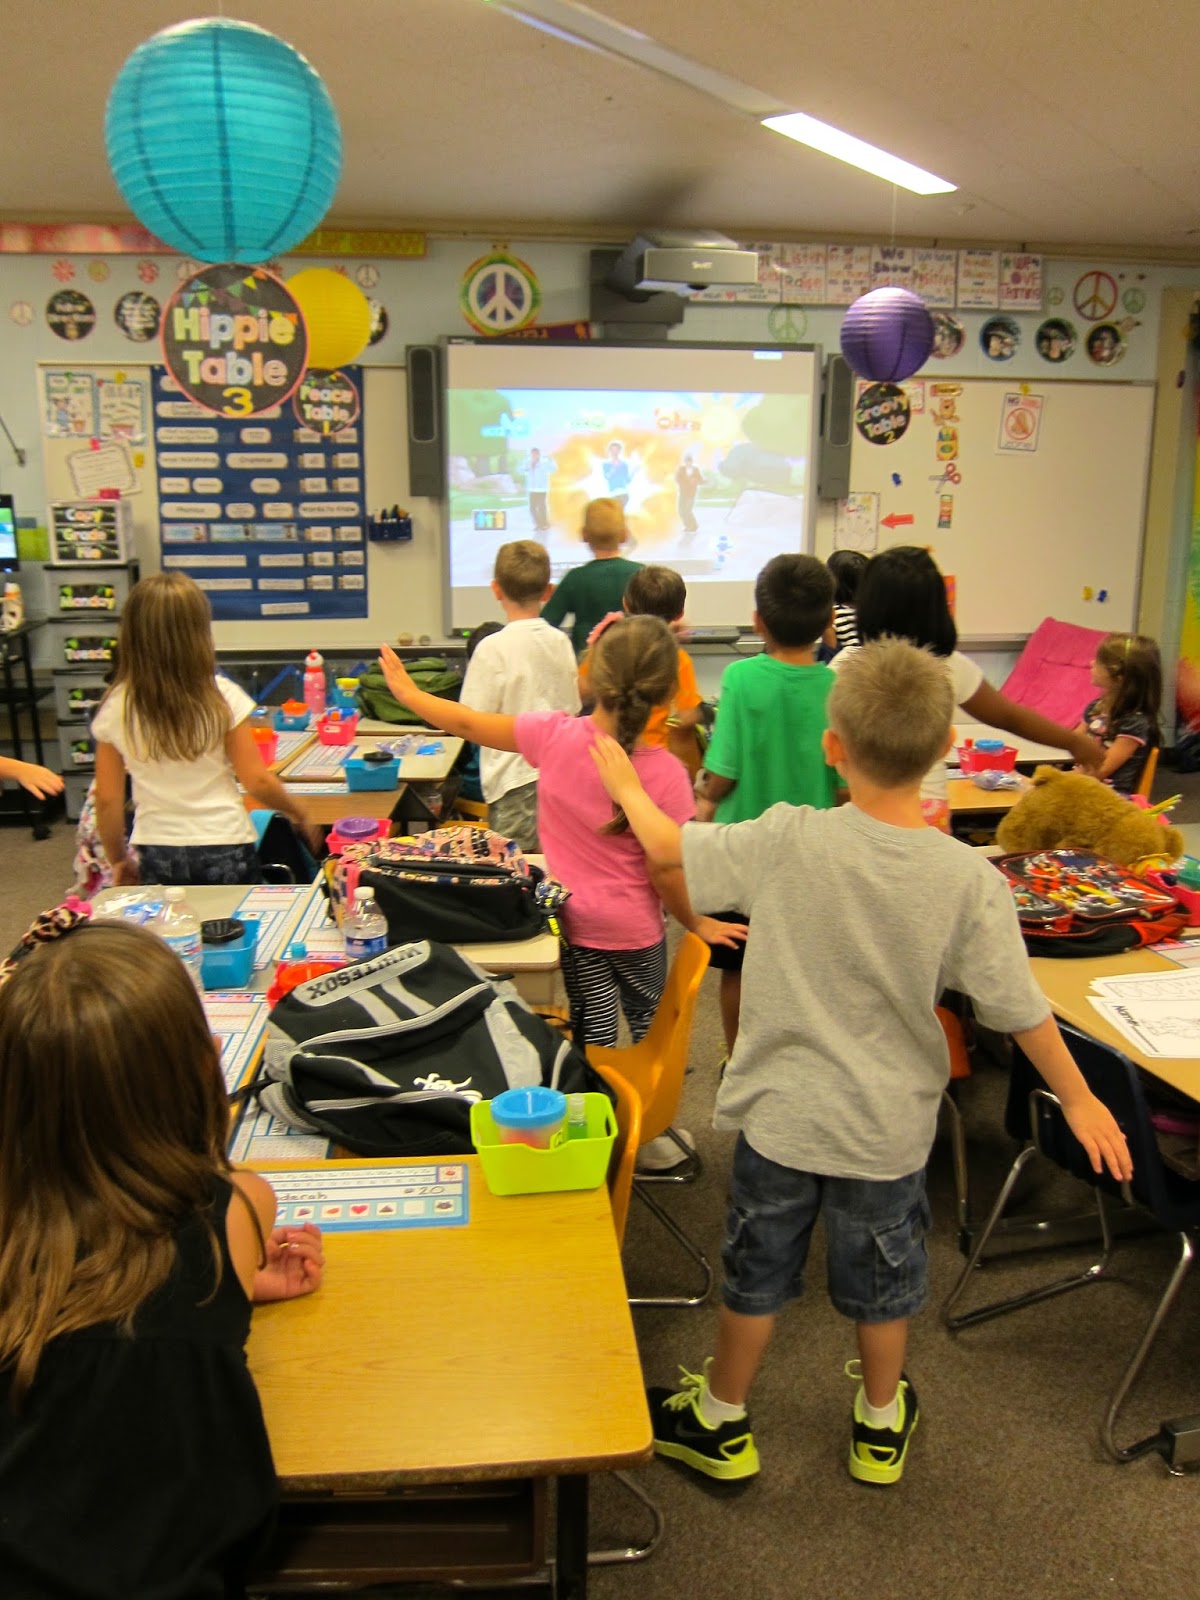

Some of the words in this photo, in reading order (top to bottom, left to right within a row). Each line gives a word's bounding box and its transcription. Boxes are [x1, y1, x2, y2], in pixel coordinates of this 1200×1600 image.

[173, 306, 295, 349] Hippie
[182, 351, 288, 386] Table
[222, 387, 254, 416] 3
[303, 404, 350, 421] Table
[864, 415, 906, 437] Table
[885, 431, 896, 443] 2
[65, 509, 103, 523] Copy
[63, 528, 107, 541] Grade
[60, 595, 115, 609] Monday
